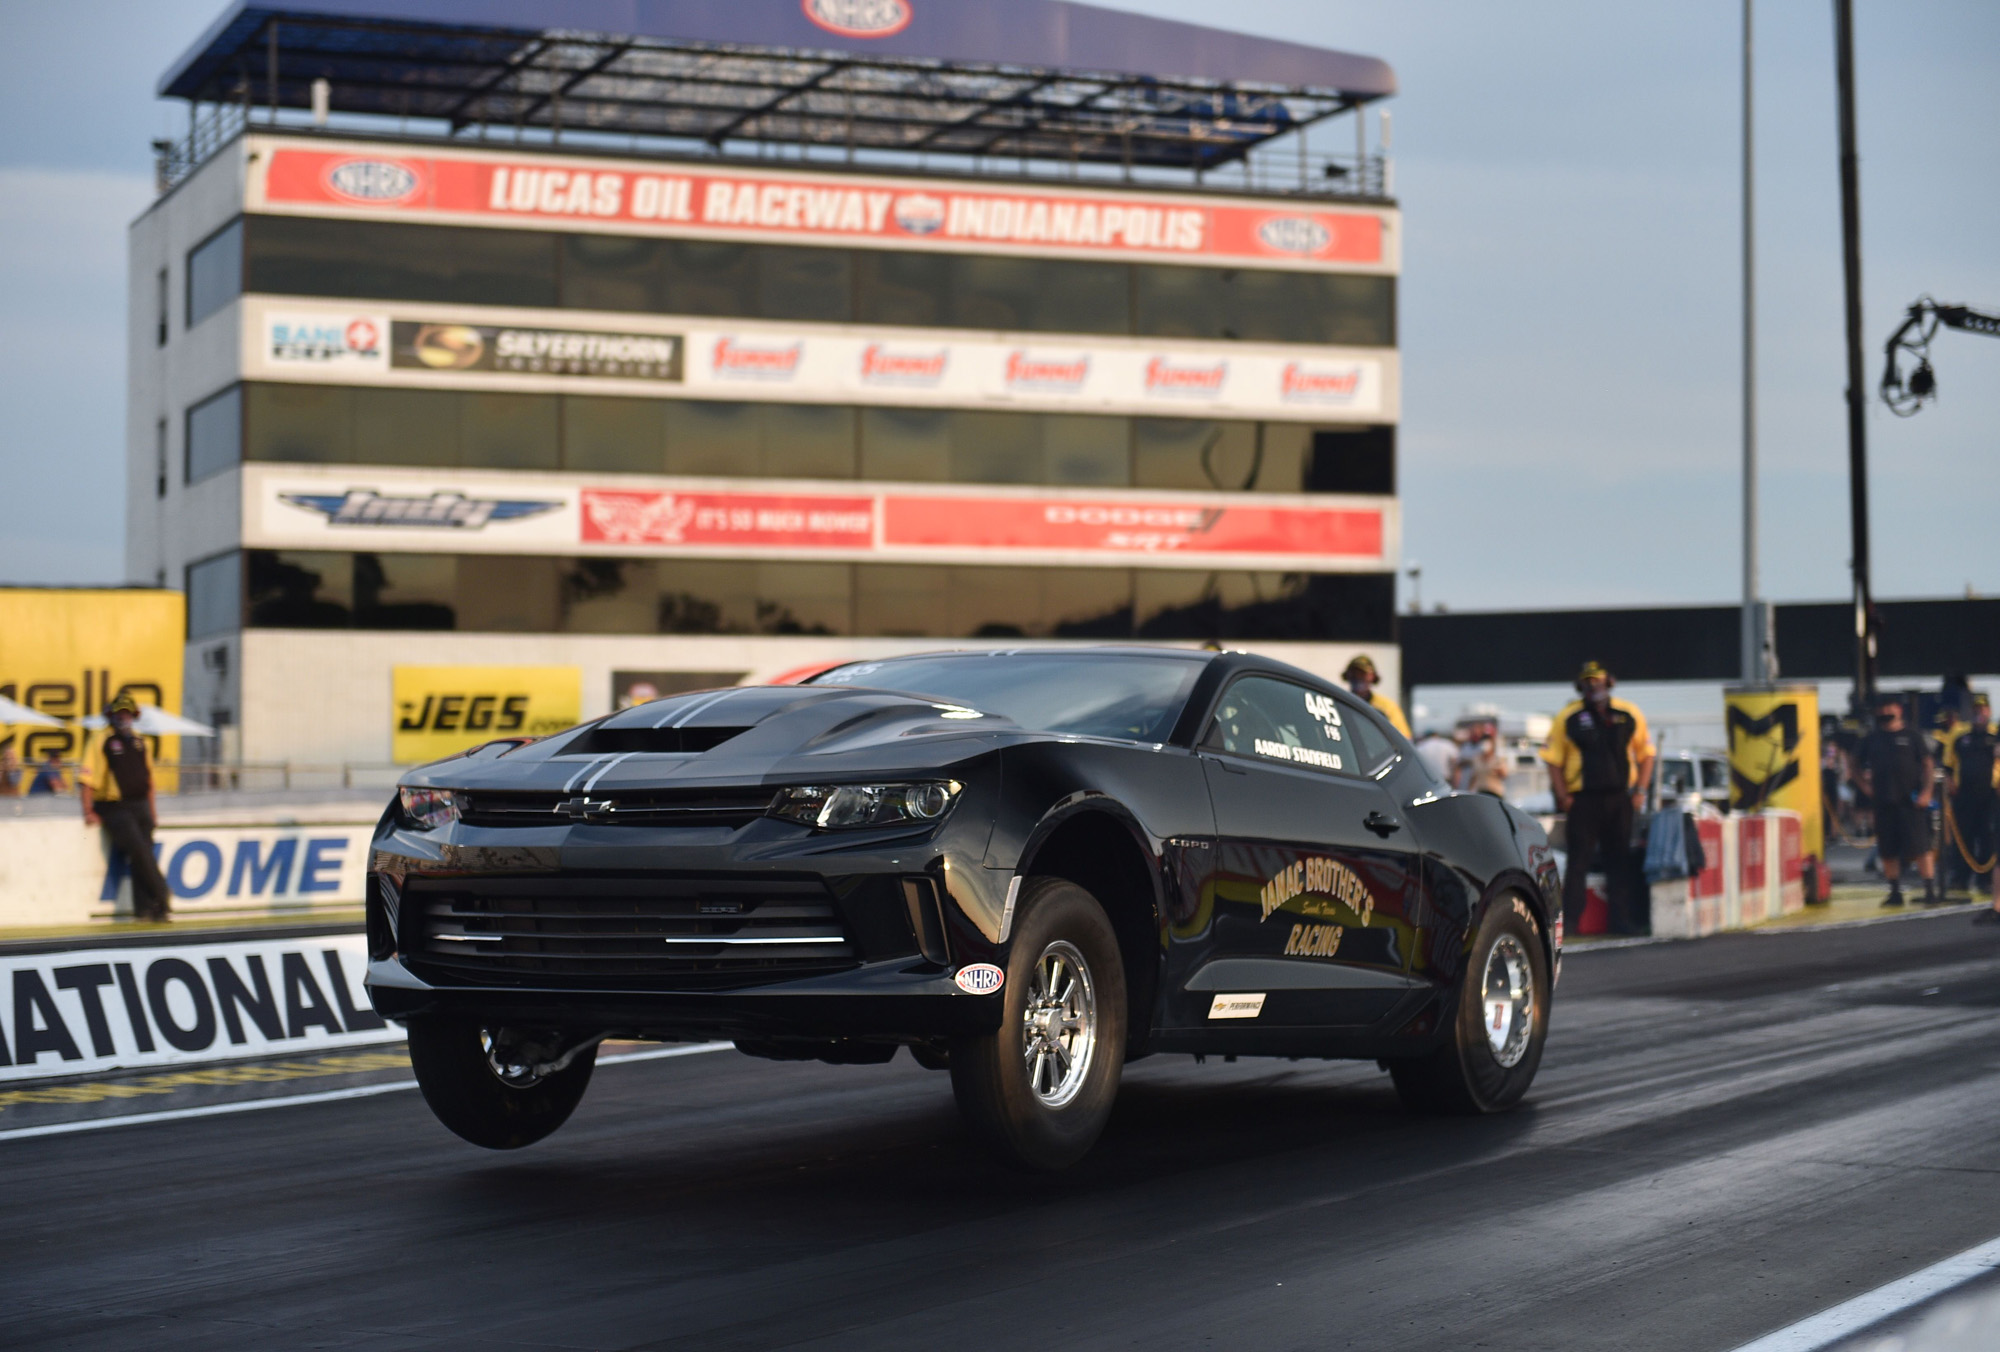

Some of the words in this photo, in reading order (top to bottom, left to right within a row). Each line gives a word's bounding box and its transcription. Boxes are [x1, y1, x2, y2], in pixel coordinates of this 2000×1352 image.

[490, 167, 624, 216] LUCAS
[631, 177, 693, 221] OIL
[704, 180, 893, 232] RACEWAY
[946, 195, 1206, 250] INDIANAPOLIS
[495, 328, 674, 362] SILVERTHORN
[1043, 505, 1202, 527] DODGE
[399, 694, 529, 731] JEGS
[1305, 692, 1342, 727] 445
[1255, 738, 1292, 760] AARON
[1292, 746, 1343, 770] STANFIELD
[1260, 860, 1304, 924] JANAC
[1284, 923, 1343, 958] RACING
[964, 969, 999, 989] NHRA
[0, 949, 388, 1067] ATIONAL
